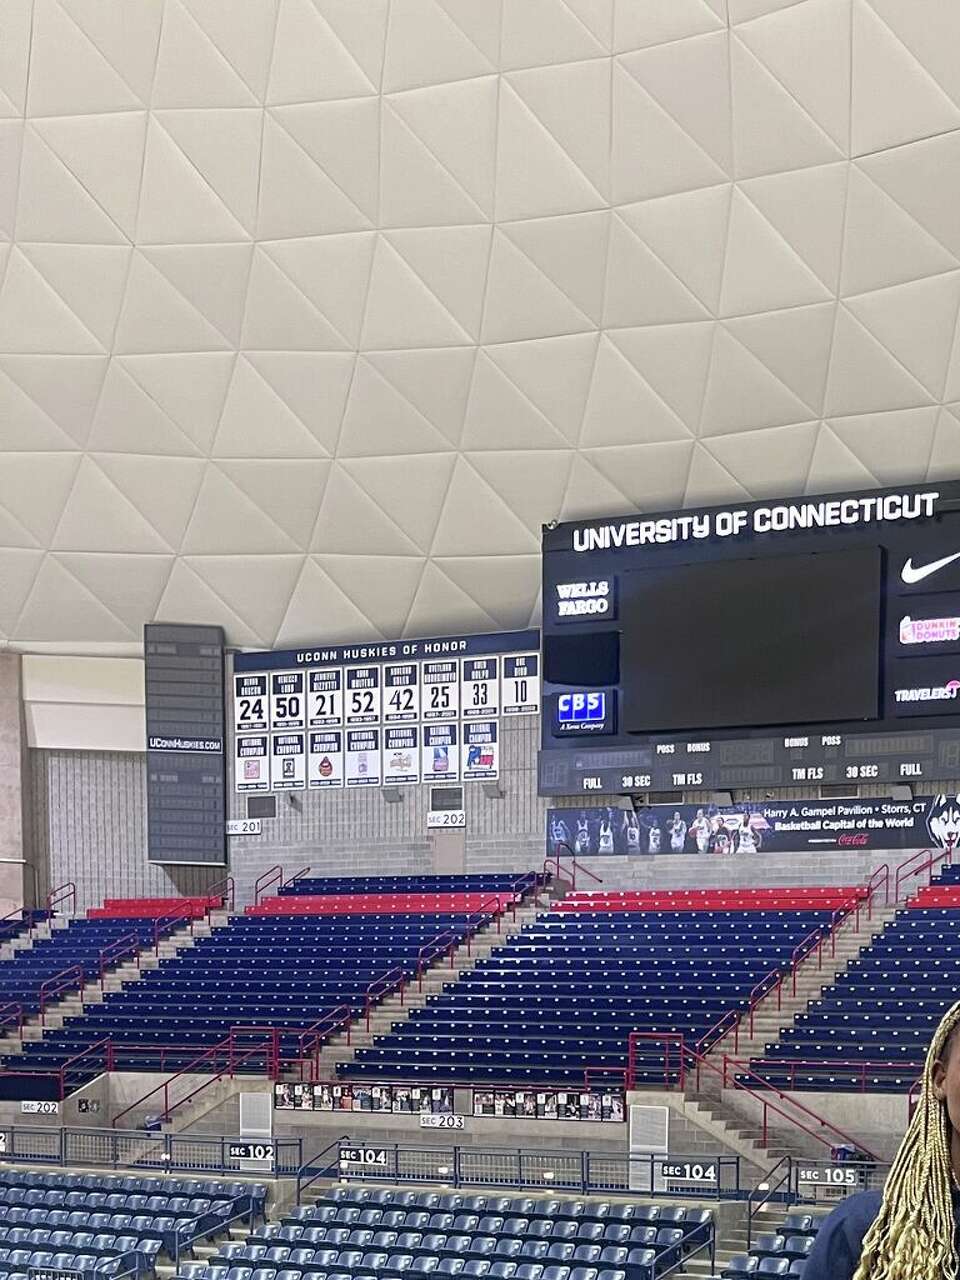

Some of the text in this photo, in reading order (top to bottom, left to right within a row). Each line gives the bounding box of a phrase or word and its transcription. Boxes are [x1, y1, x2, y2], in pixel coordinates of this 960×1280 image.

[573, 492, 939, 552] UNIVERSITY OF CONNECTICUT
[556, 581, 609, 599] WELLS
[557, 598, 608, 616] FARGO
[916, 630, 956, 640] DONUTS
[297, 641, 467, 663] UCONN HUSKIES OF HONOR
[431, 686, 450, 709] 25
[473, 683, 488, 706] 33
[514, 680, 527, 703] 10
[894, 687, 952, 702] TRAVELERS
[316, 694, 335, 716] 21
[352, 691, 374, 713] 52
[389, 688, 414, 711] 42
[558, 693, 600, 712] CBS
[239, 699, 264, 721] 24
[276, 697, 300, 718] 50
[686, 742, 711, 753] BONUS
[784, 737, 809, 748] BONUS
[821, 735, 841, 746] POSS
[656, 744, 675, 754] POSS
[792, 767, 824, 781] TM FLS
[846, 765, 878, 778] 30 SEC
[899, 763, 922, 776] FULL
[583, 777, 602, 789] FULL
[622, 775, 651, 788] 30 SEC
[672, 772, 703, 786] TM FLS
[763, 802, 926, 820] Harry A. Gampel Pavilion Storrs, CT
[242, 821, 260, 832] 201
[443, 813, 466, 825] 202
[774, 817, 914, 832] Basketball Capital of the World
[37, 1102, 57, 1113] 202
[421, 1115, 464, 1128] SEC 203
[230, 1145, 274, 1160] SEC 102
[340, 1149, 386, 1164] SEC 104
[663, 1164, 716, 1181] SEC 104
[800, 1168, 855, 1183] SEC 105
